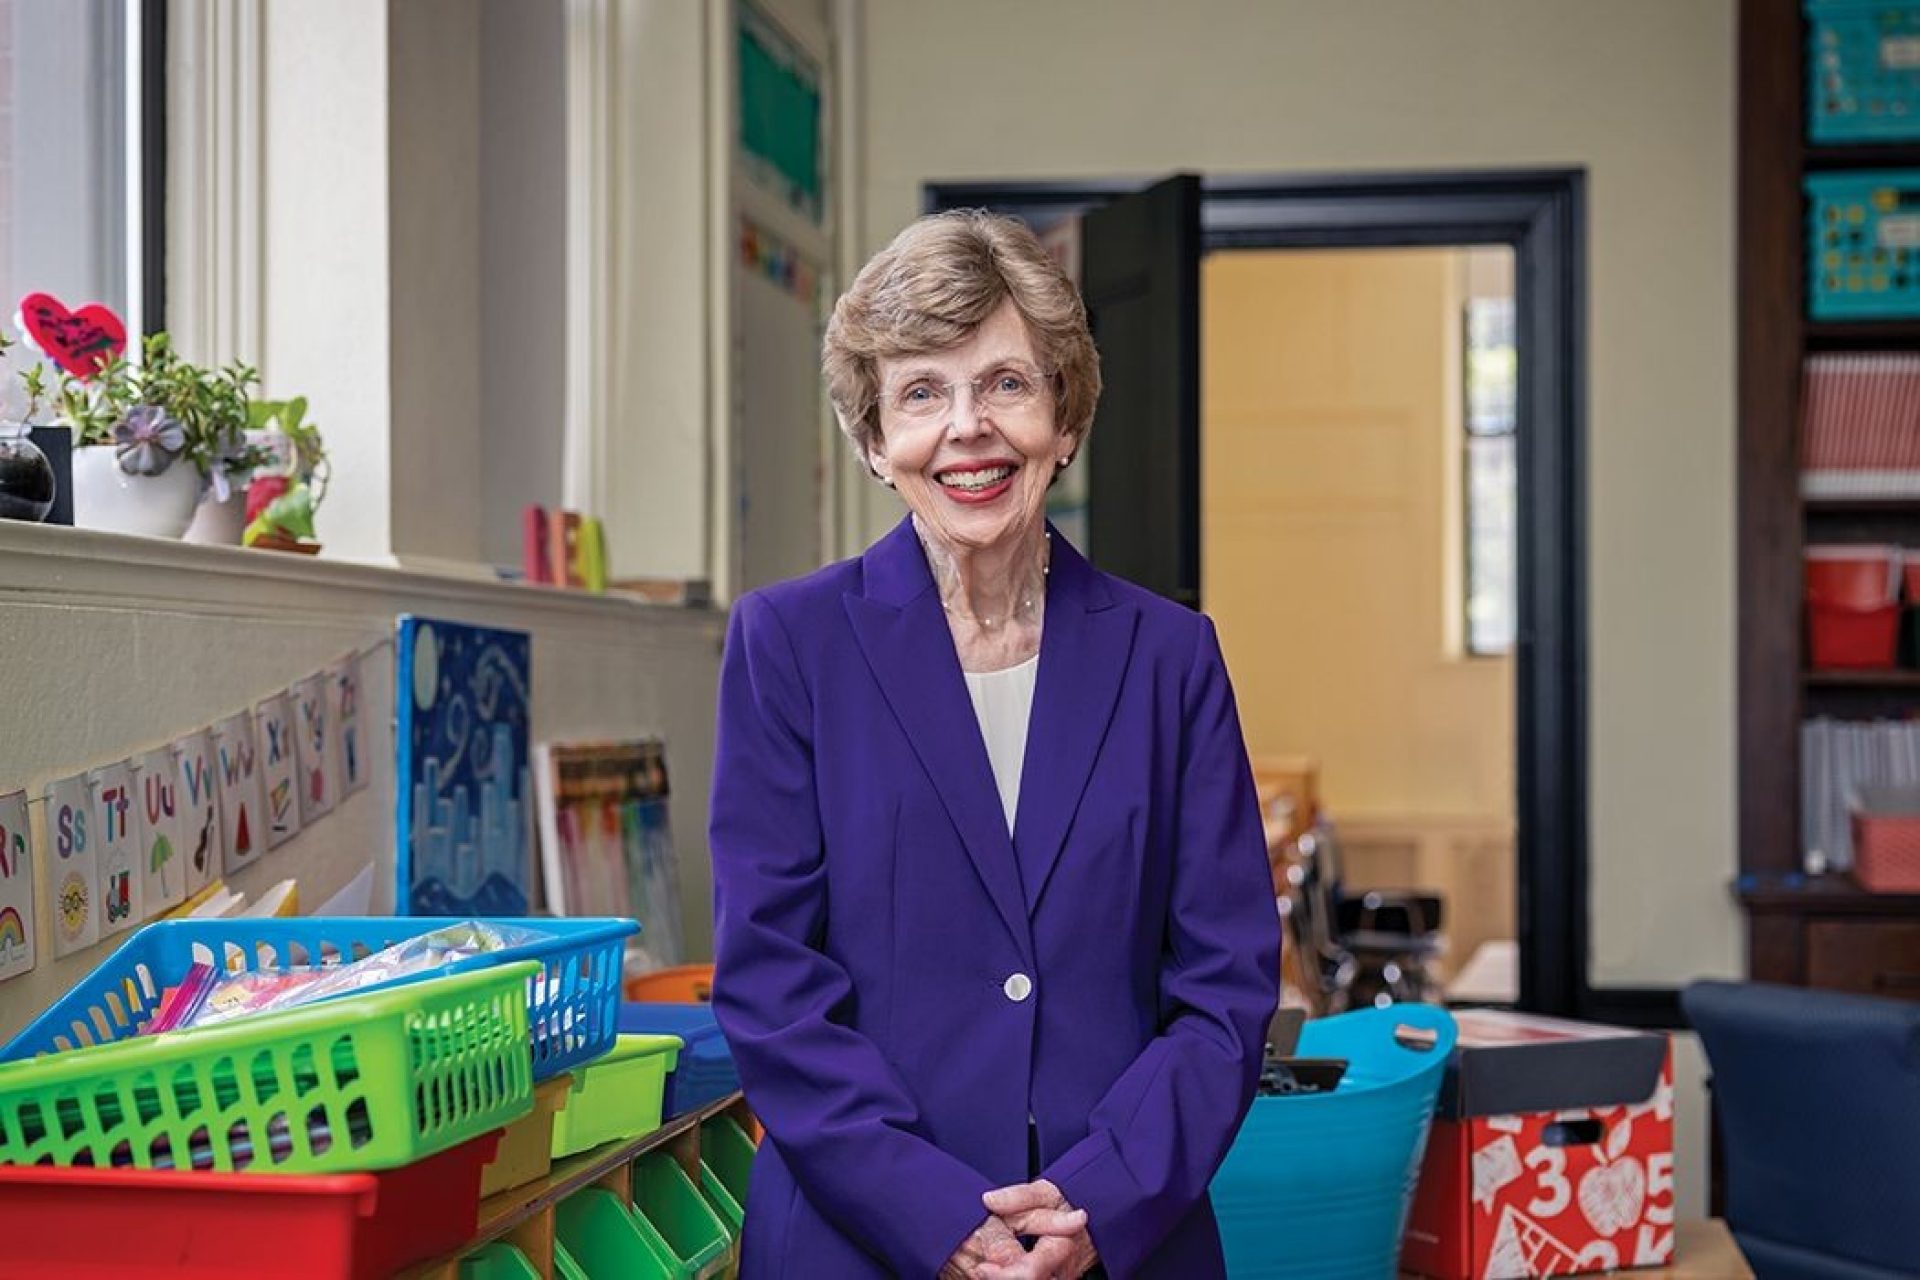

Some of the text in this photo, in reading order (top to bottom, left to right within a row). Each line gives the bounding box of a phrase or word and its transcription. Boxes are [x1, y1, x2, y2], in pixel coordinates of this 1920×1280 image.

[102, 784, 129, 842] Tt
[146, 773, 174, 825] Uu
[58, 804, 86, 859] Ss
[1525, 1145, 1571, 1217] 3
